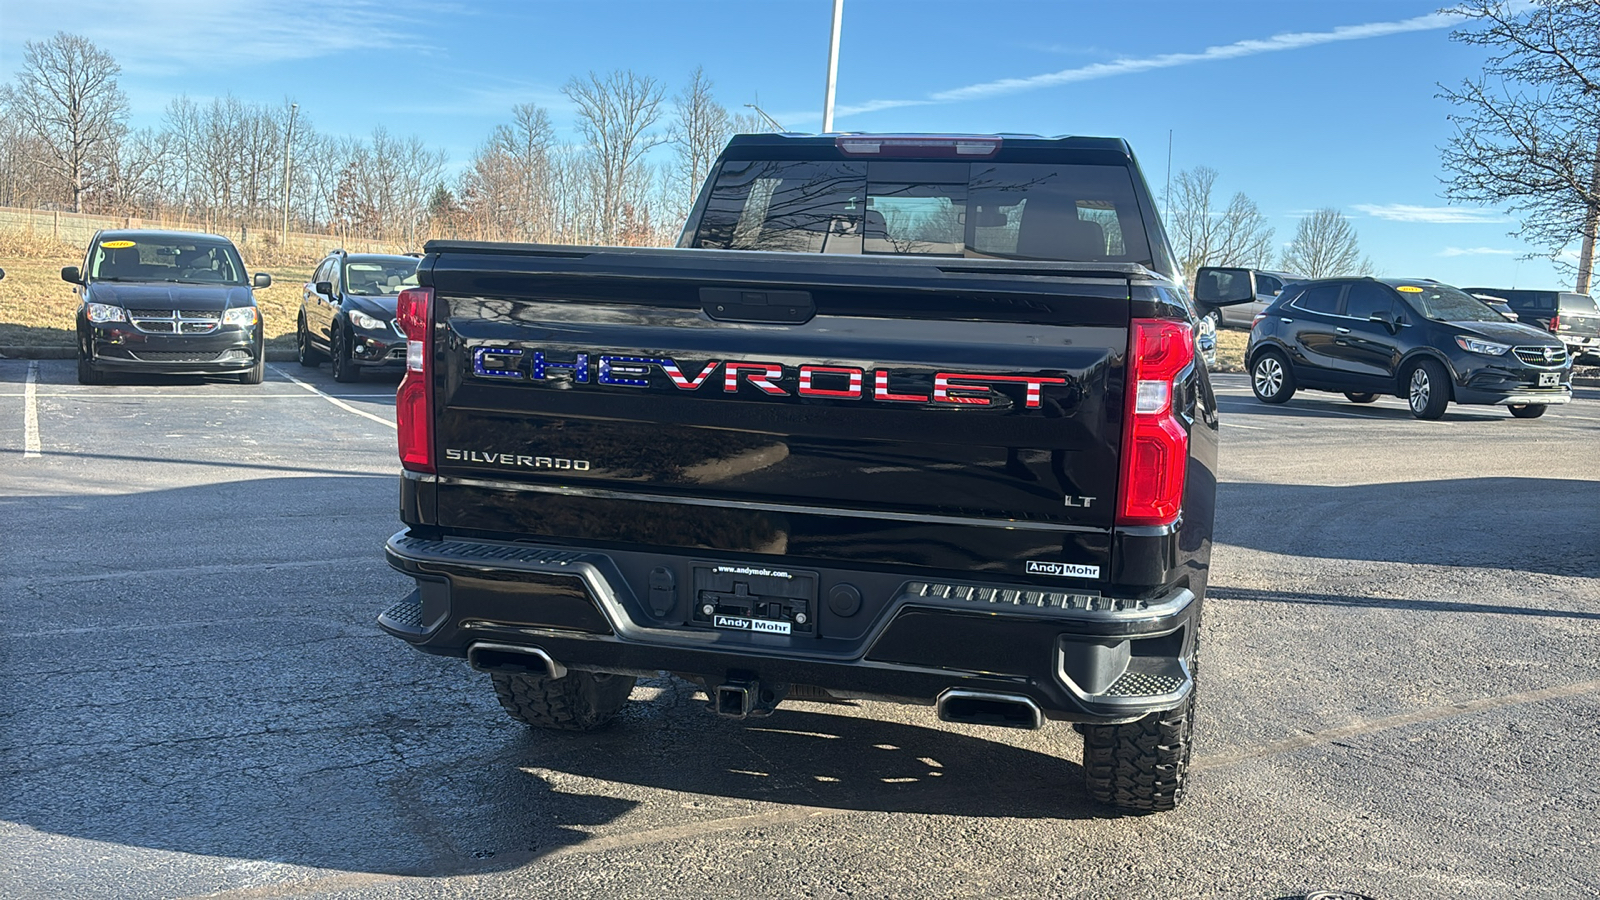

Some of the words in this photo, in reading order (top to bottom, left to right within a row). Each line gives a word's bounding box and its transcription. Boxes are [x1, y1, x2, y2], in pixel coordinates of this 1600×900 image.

[472, 346, 1069, 408] CHEVROLET
[445, 448, 590, 471] SILVERADO
[1064, 494, 1096, 507] LT
[718, 565, 788, 578] www.andymohr.com
[1029, 562, 1062, 574] Andy
[1065, 565, 1098, 575] Mohr
[718, 617, 750, 629] Andy
[754, 621, 788, 632] Mohr
